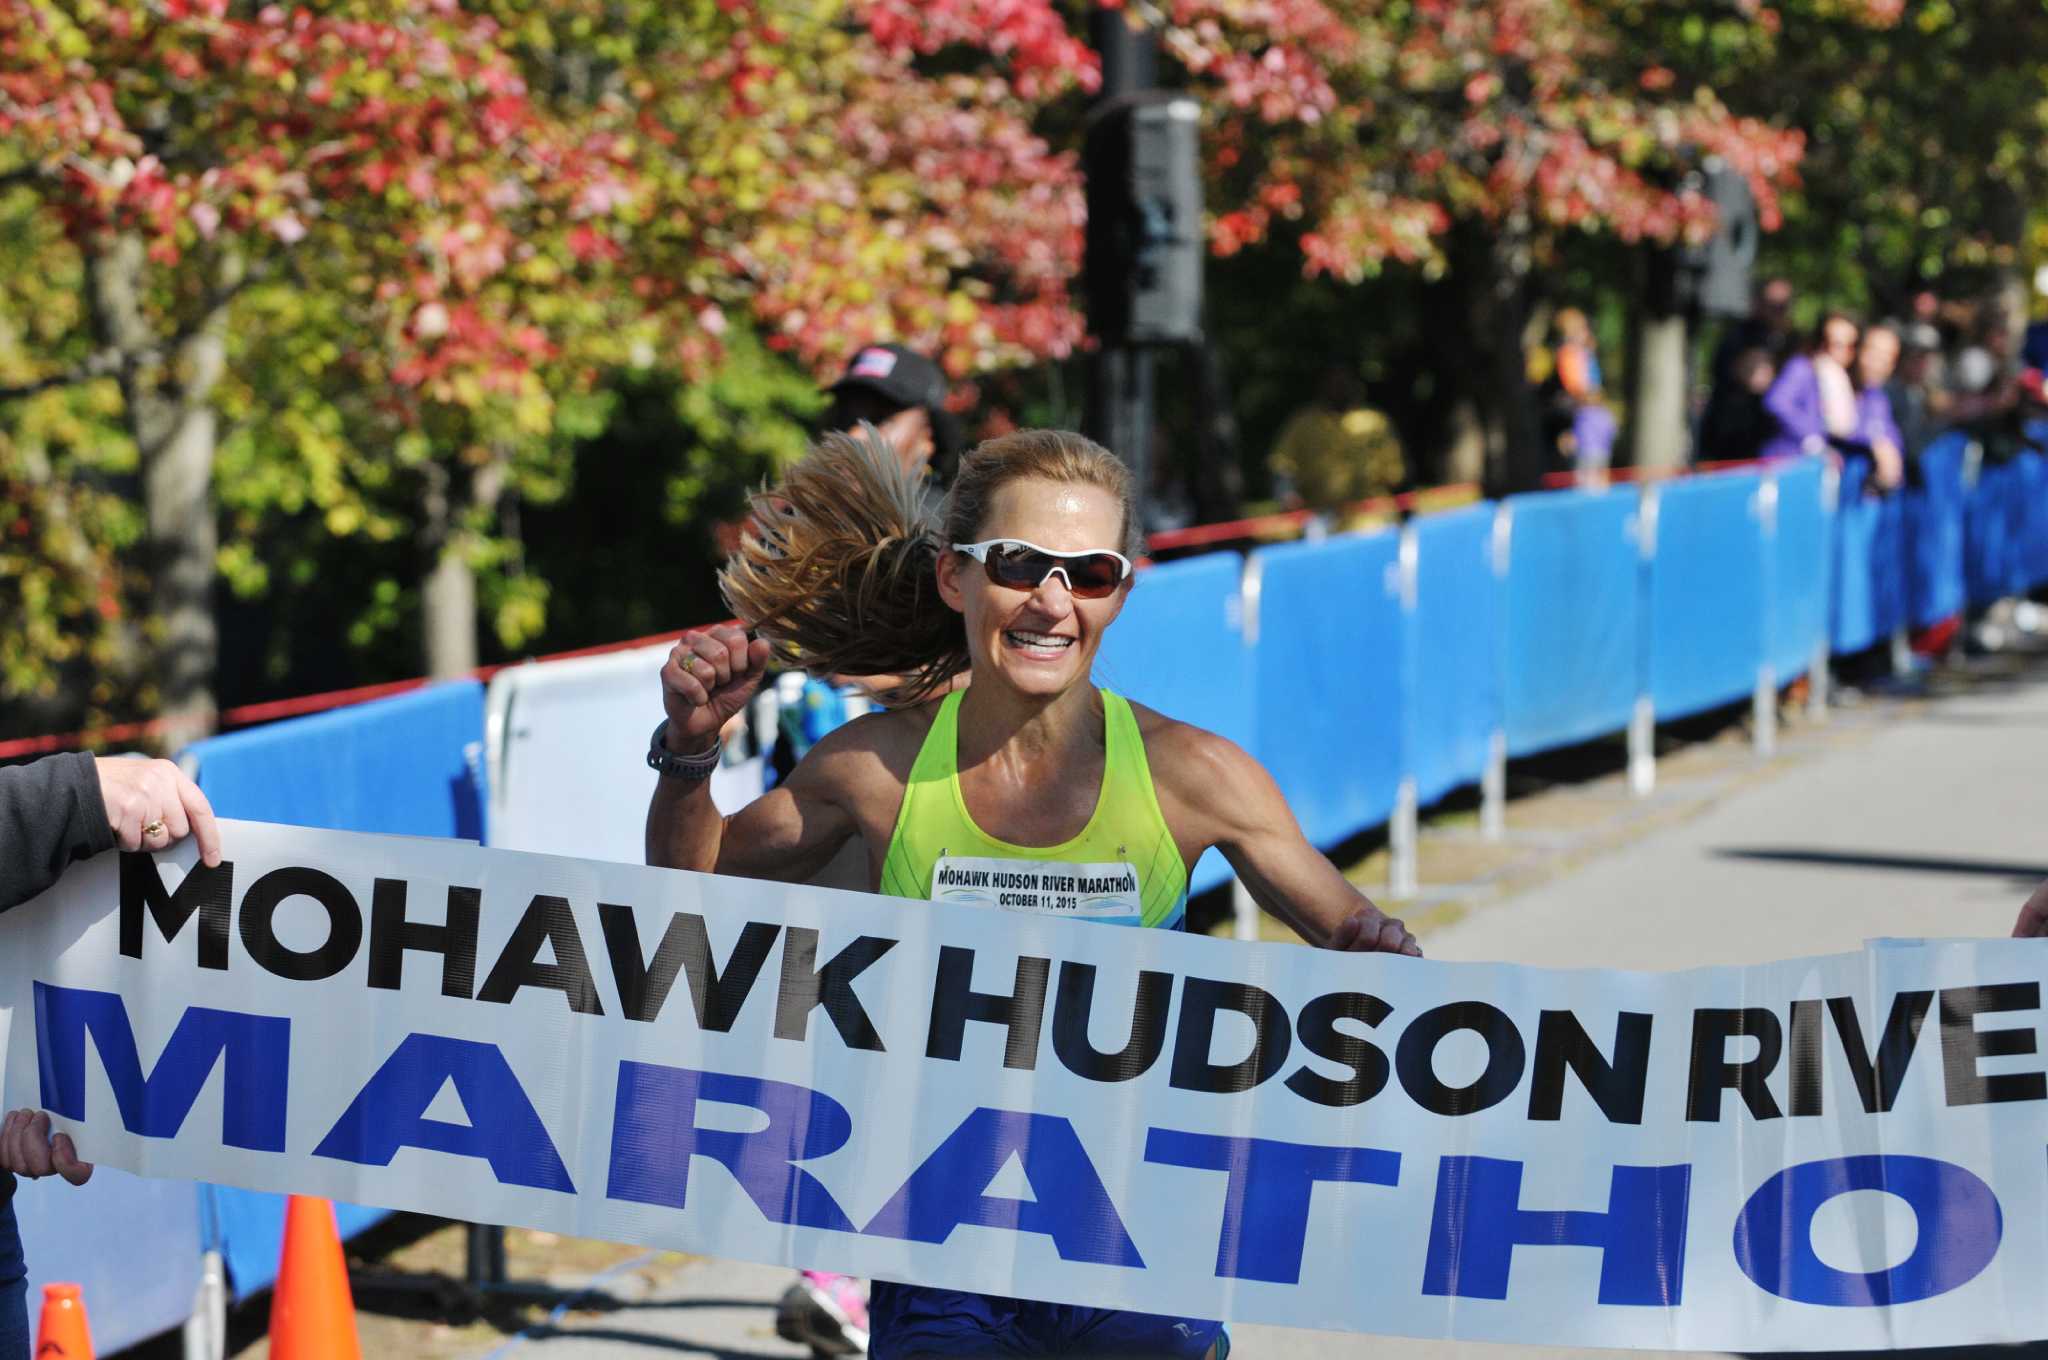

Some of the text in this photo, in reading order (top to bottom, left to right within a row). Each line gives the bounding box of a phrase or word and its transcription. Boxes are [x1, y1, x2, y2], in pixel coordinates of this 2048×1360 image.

[938, 869, 1136, 893] MOHAWK HUDSON RIVER MARATHON
[1000, 893, 1077, 910] OCTOBER 11, 2015
[119, 852, 2047, 1125] MOHAWK HUDSON RIVE
[33, 979, 2048, 1308] MARATHO
